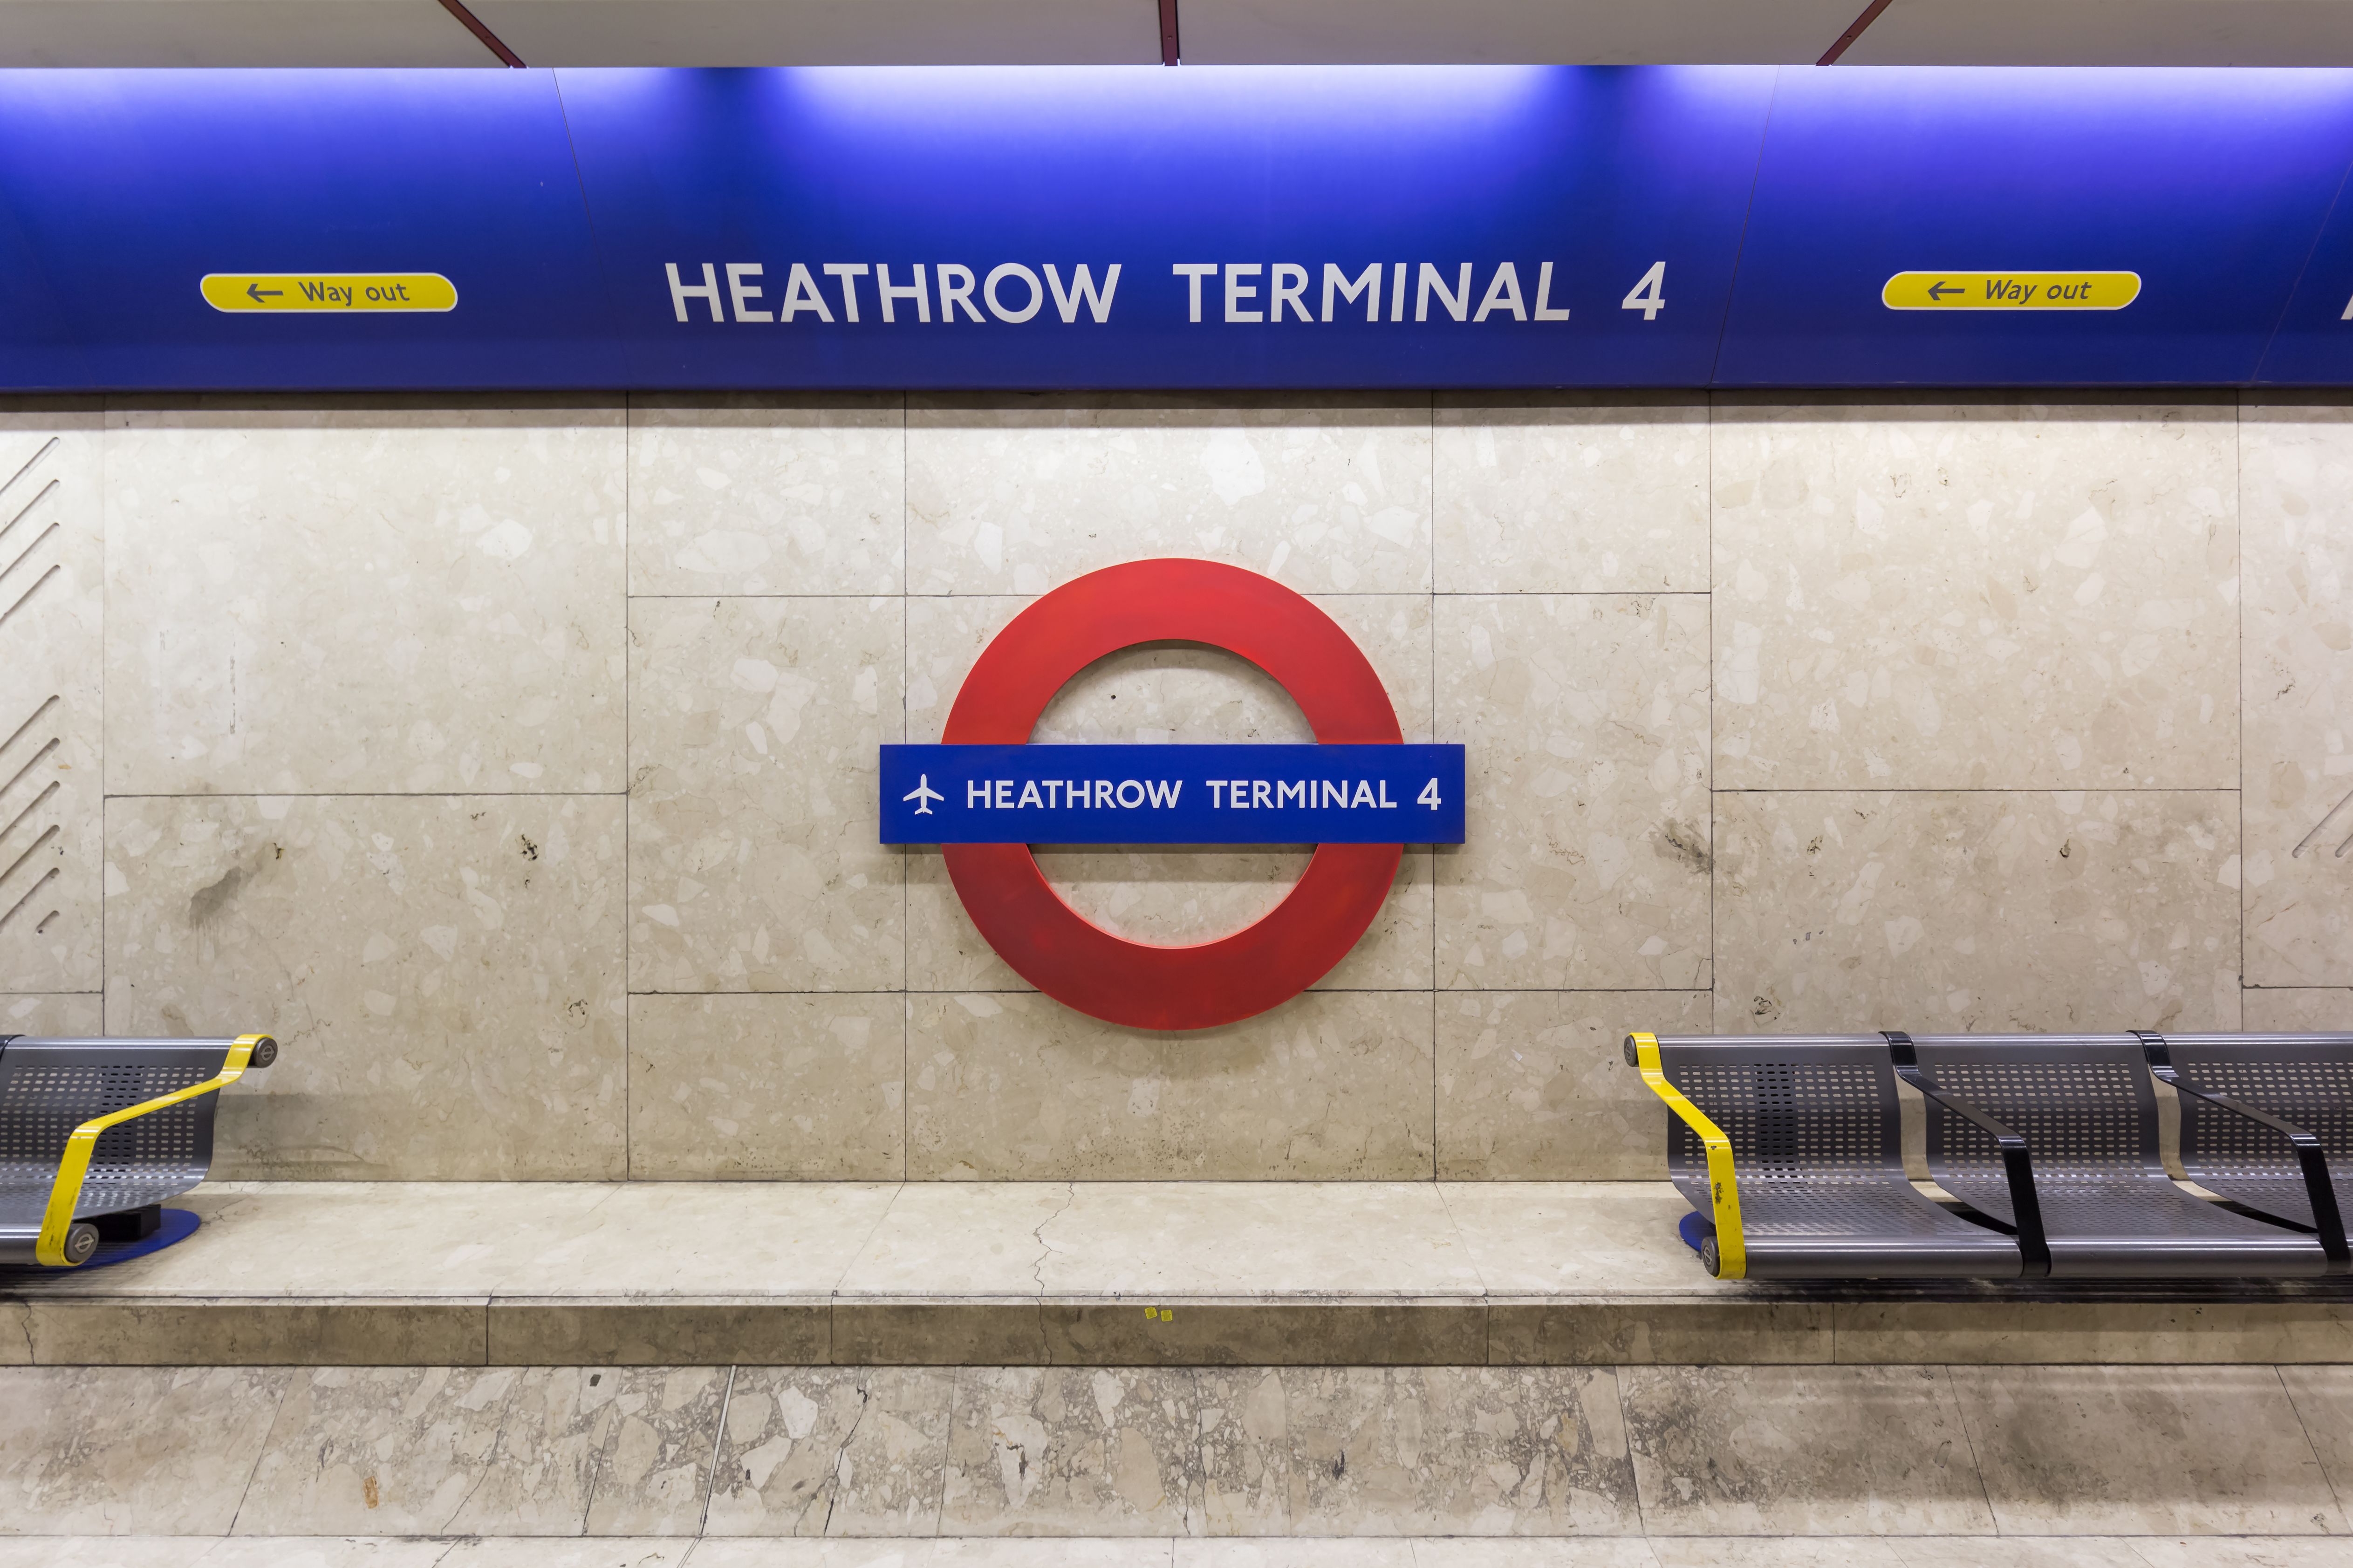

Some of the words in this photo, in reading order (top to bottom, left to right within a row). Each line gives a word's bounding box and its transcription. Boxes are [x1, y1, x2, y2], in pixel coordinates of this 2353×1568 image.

[298, 281, 352, 307] Way
[365, 283, 410, 301] out
[665, 262, 1122, 323] HEATHROW
[1172, 262, 1570, 322] TERMINAL
[1621, 261, 1666, 320] 4
[1986, 280, 2038, 305] Way
[2047, 281, 2092, 300] out
[967, 779, 1183, 809] HEATHROW
[1206, 780, 1397, 808] TERMINAL
[1417, 777, 1442, 811] 4
